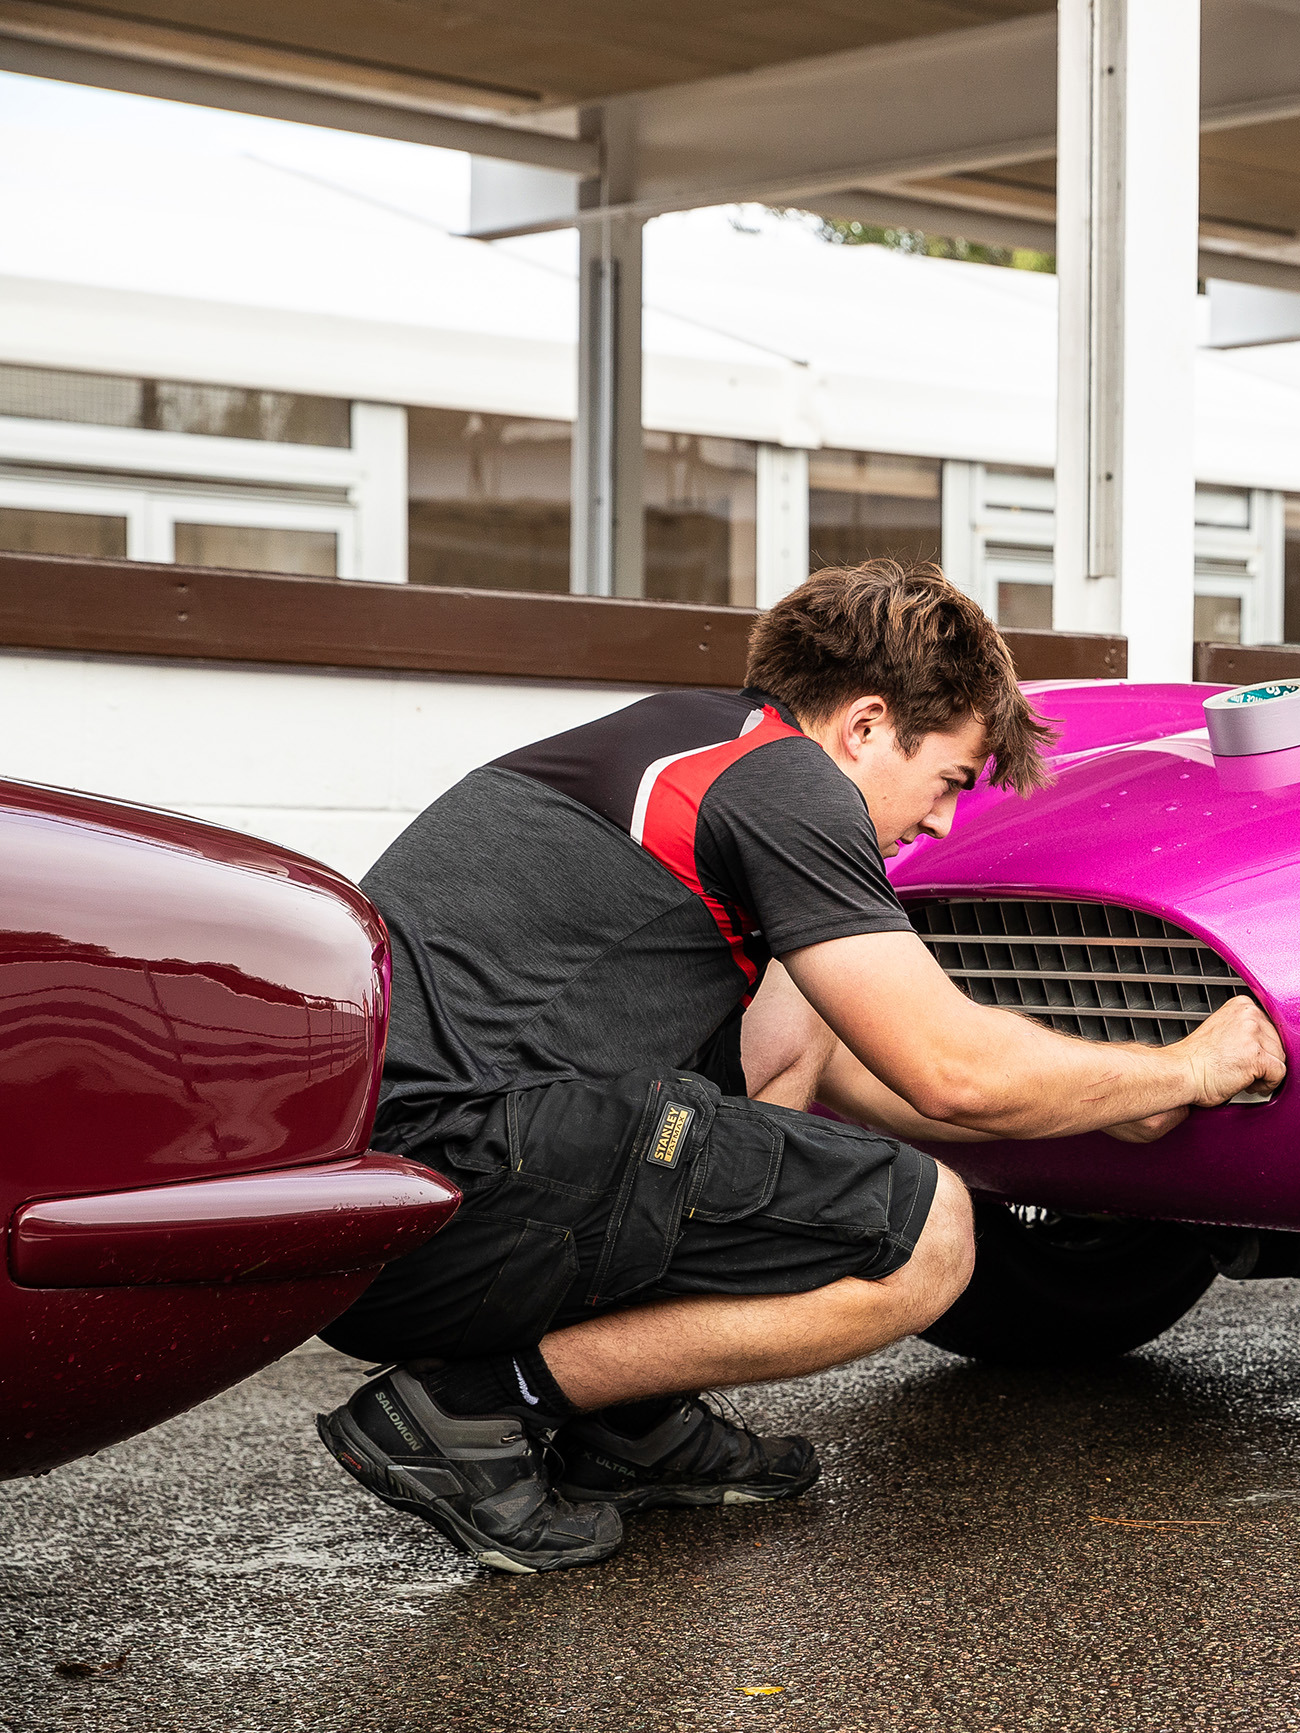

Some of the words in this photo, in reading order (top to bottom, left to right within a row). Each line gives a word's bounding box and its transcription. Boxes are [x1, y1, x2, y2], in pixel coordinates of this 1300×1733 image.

[654, 1106, 680, 1160] STANLEY
[667, 1115, 685, 1157] FATMAX
[375, 1390, 424, 1452] SALOMON
[595, 1456, 636, 1478] ULTRA
